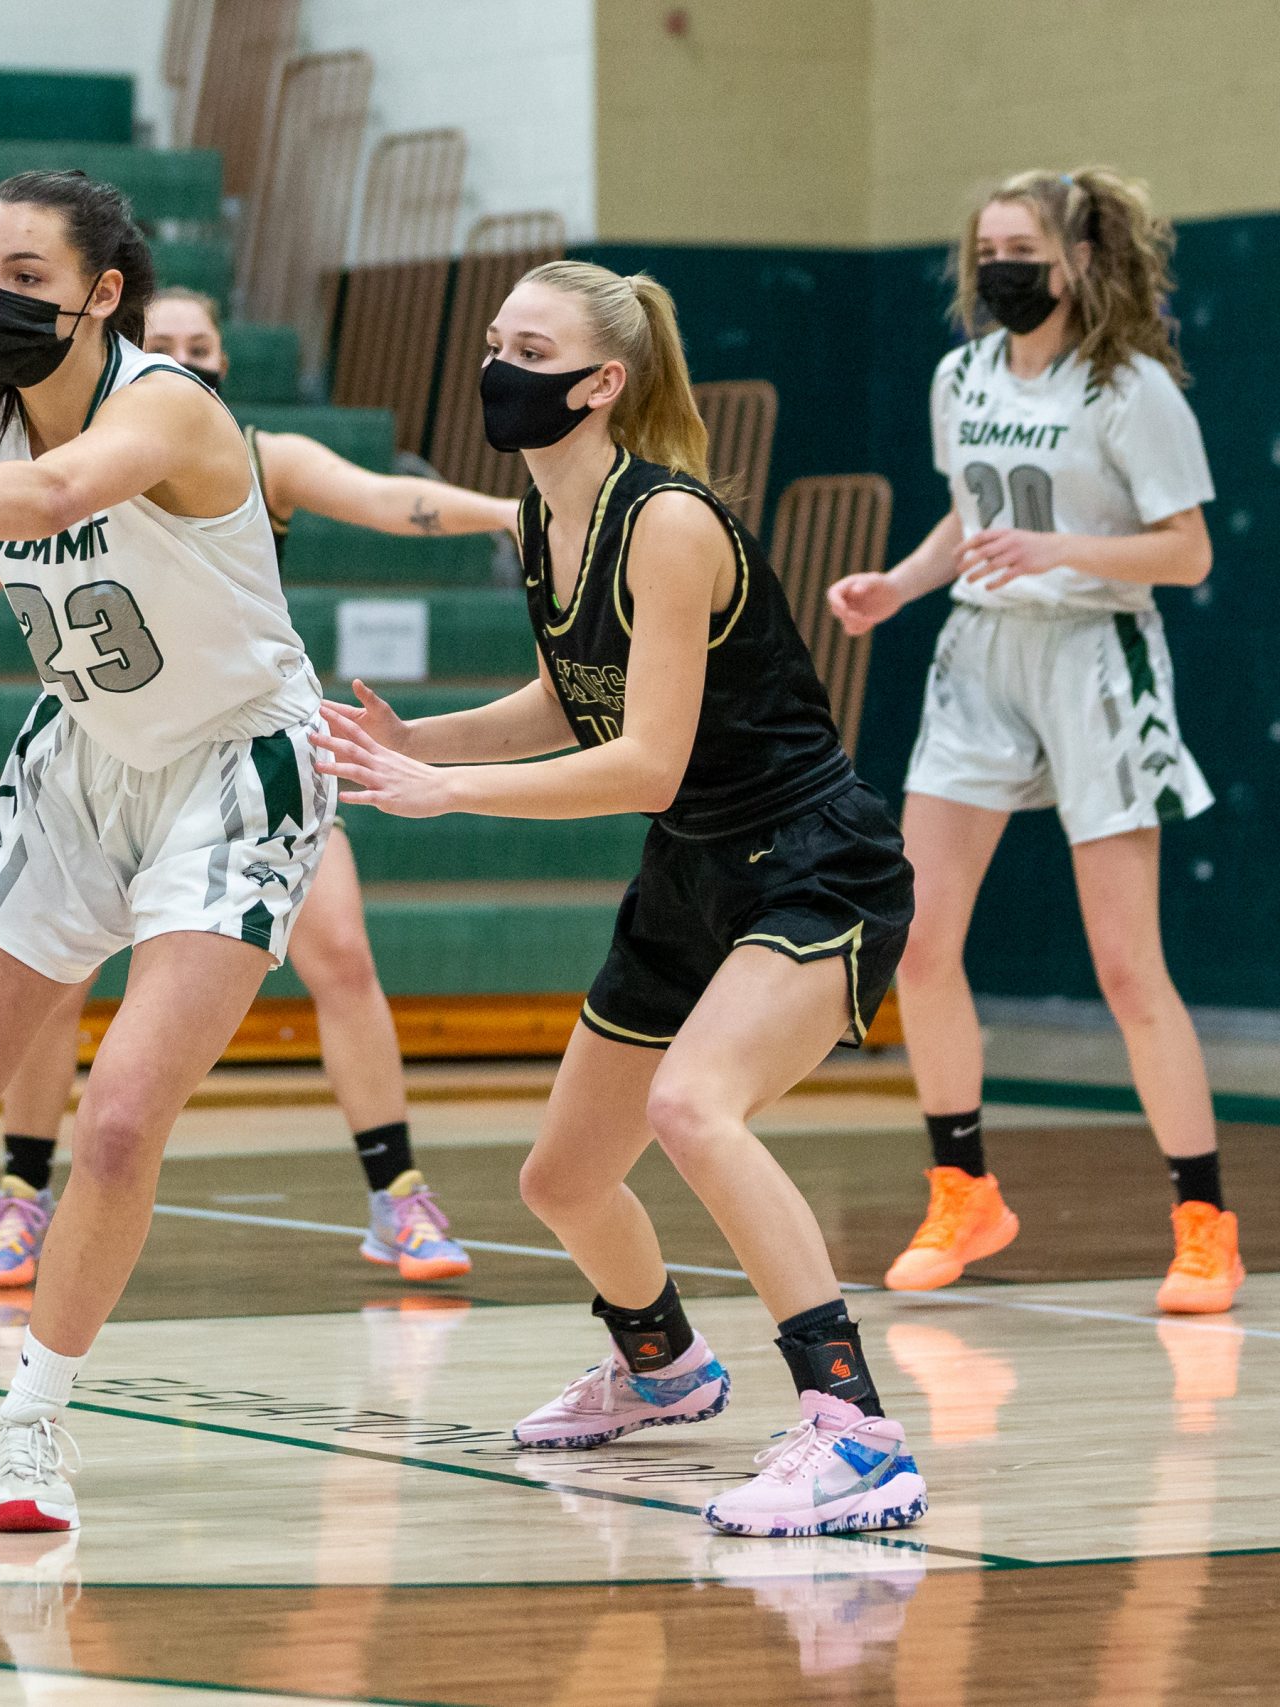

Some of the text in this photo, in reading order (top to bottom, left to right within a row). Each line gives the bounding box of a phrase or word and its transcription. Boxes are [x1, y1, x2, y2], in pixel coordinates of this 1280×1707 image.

[958, 420, 1069, 450] SUMMIT
[3, 579, 164, 703] 23
[73, 1376, 513, 1444] ELEVATION
